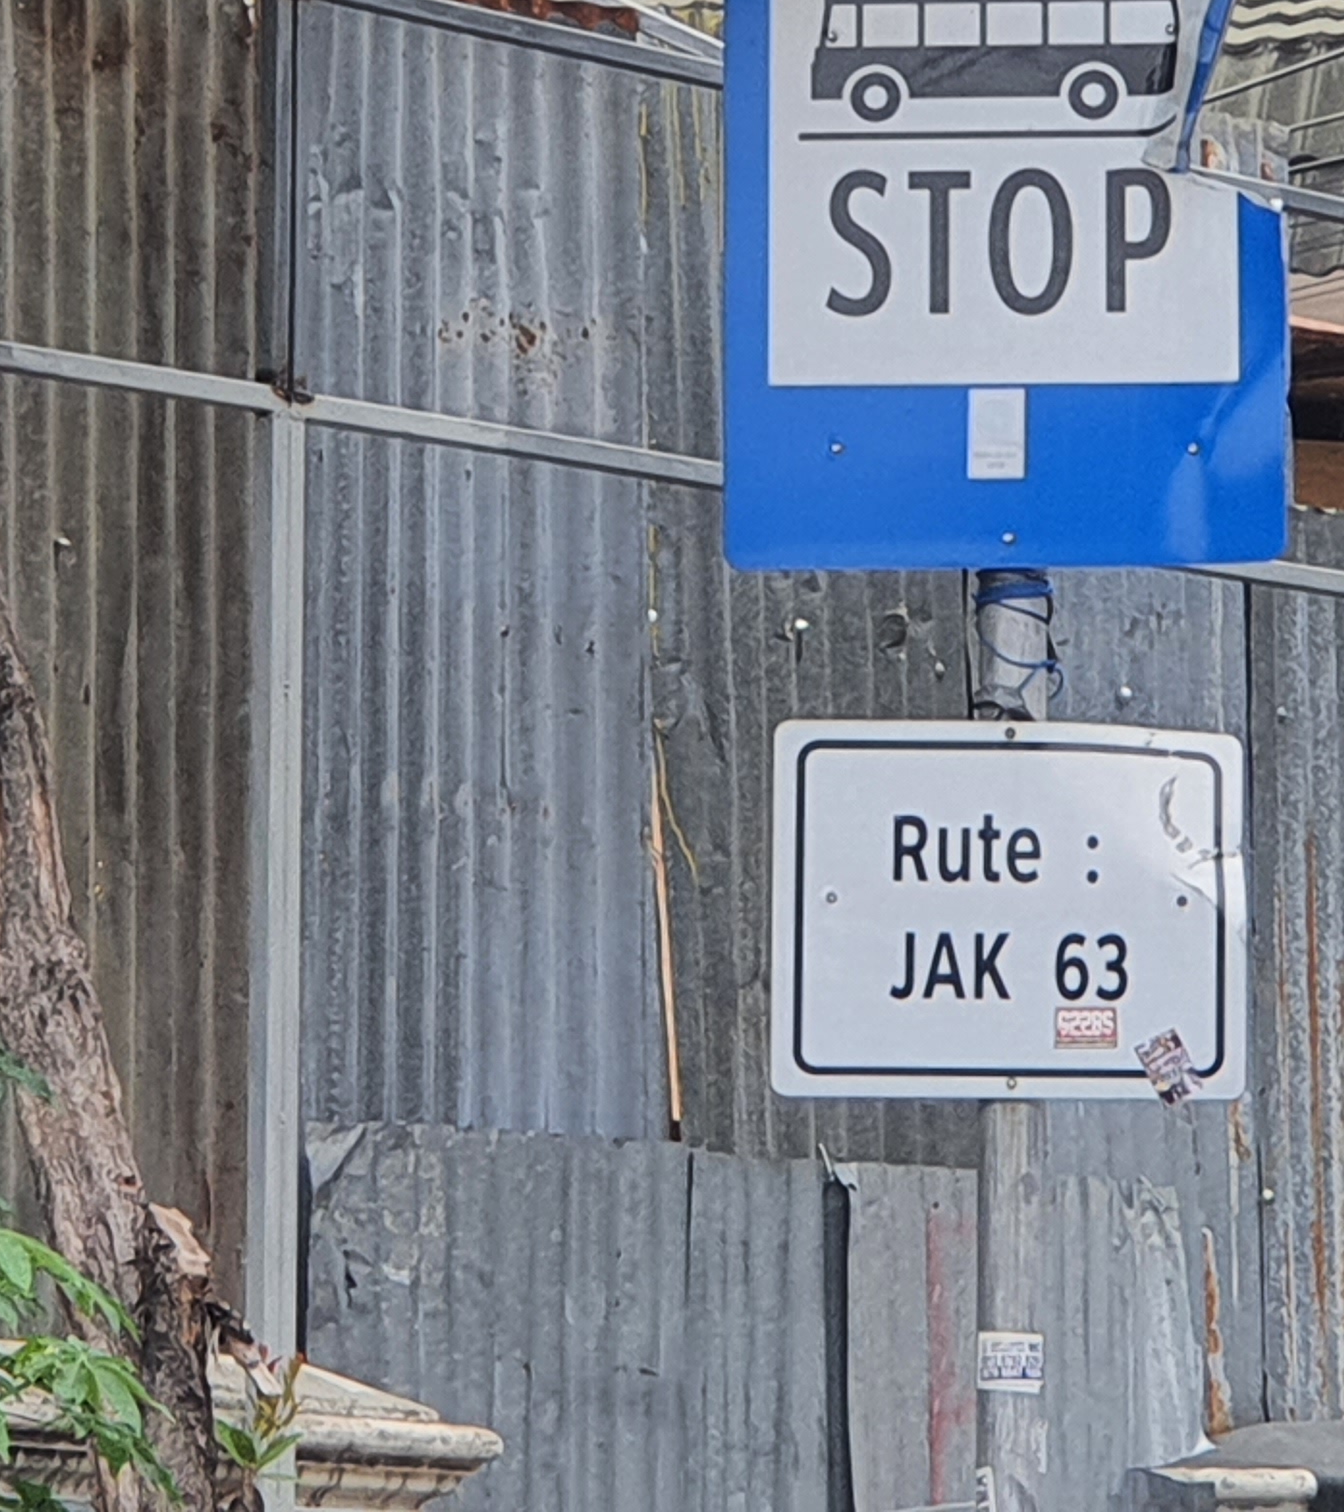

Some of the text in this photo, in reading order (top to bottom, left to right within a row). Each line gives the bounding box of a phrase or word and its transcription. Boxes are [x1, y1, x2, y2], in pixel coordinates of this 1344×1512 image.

[825, 167, 1173, 317] STOP
[891, 813, 1042, 885] Rute
[889, 931, 1129, 1002] JAK 63
